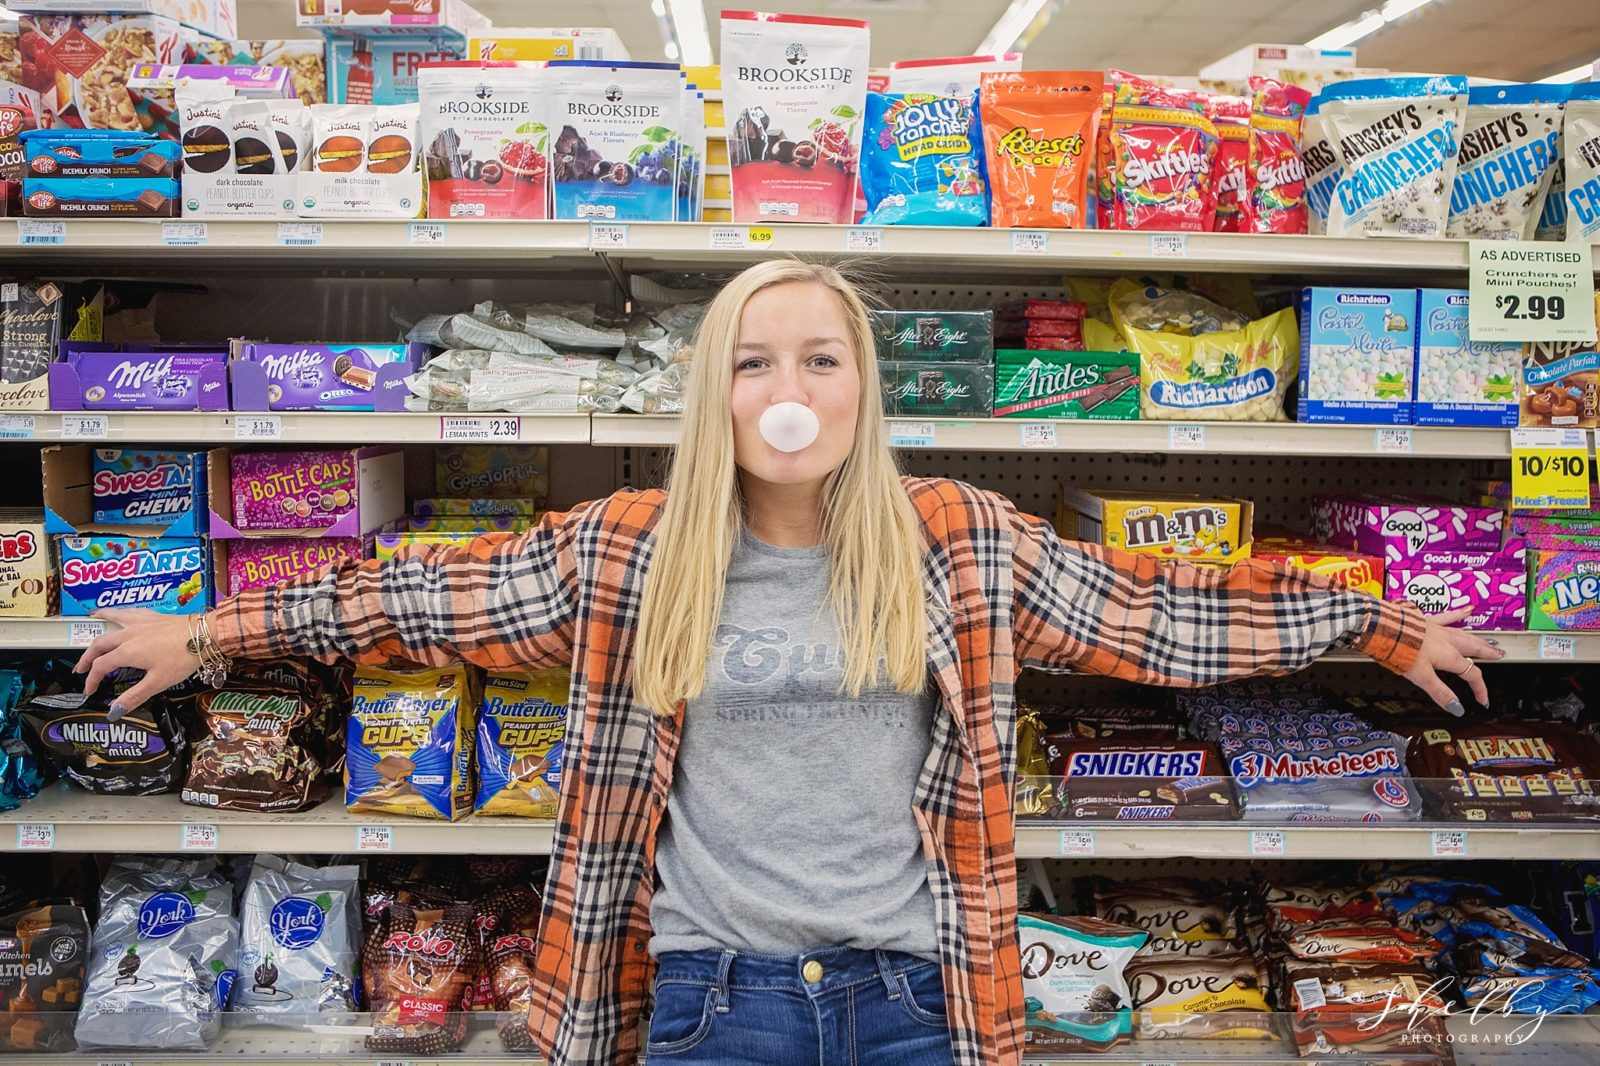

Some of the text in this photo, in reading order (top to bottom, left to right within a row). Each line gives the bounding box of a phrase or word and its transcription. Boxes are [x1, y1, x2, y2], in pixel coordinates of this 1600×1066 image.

[738, 67, 852, 84] BROOKSIDE
[440, 102, 530, 115] BROOKSIDE
[567, 103, 659, 118] BROOKSIDE
[775, 100, 819, 108] Pomegranate
[186, 108, 222, 121] Justin's
[895, 98, 960, 133] JOLLY
[232, 120, 259, 131] ustin's
[328, 122, 361, 132] Justin's
[374, 119, 407, 131] Justin's
[900, 117, 969, 145] rancher
[464, 129, 503, 137] Pomegranate
[608, 130, 639, 139] Blueberry
[998, 127, 1084, 156] Reese's
[1124, 152, 1209, 188] Skittles
[1256, 160, 1306, 189] Skittl
[216, 178, 263, 186] dark chocolate
[335, 177, 380, 185] milk chocolate
[206, 188, 227, 200] PEANUT
[231, 189, 255, 200] BUTTER
[227, 201, 254, 209] organic
[344, 199, 371, 208] organic
[1480, 251, 1581, 263] AS ADVERTISED
[1485, 269, 1559, 279] Crunchers
[1486, 279, 1577, 288] Mini Pouches!
[1341, 295, 1388, 304] Richardson
[1495, 295, 1565, 321] $2.99
[1318, 305, 1364, 332] Pastel
[3, 330, 48, 344] Strong
[885, 327, 969, 346] After Eight
[1340, 333, 1407, 355] Mints
[261, 350, 325, 380] Milka
[1568, 355, 1598, 373] Parfait
[108, 355, 176, 389] Milk
[887, 380, 971, 399] After Eight
[1013, 363, 1100, 401] Andes
[320, 389, 354, 401] OREO
[1160, 375, 1270, 405] Richardson
[445, 431, 468, 439] LEMAN
[490, 420, 517, 436] $2.39
[309, 457, 352, 486] CAPS
[94, 464, 192, 496] SweeTA
[149, 490, 178, 500] MINI
[124, 496, 192, 518] CHEWY
[1128, 507, 1152, 517] PEANUT
[1126, 508, 1228, 548] m&m's
[1387, 519, 1422, 533] Good
[303, 541, 347, 569] CAPS
[1424, 553, 1452, 564] Good
[1459, 553, 1491, 567] Plenty
[122, 578, 152, 587] MINI
[1408, 584, 1445, 596] Good
[96, 582, 170, 608] CHEWY
[1413, 601, 1448, 613] lenty
[353, 696, 450, 717] Butterfinger
[486, 698, 567, 718] Butterfing
[247, 716, 282, 730] minis
[366, 717, 430, 727] PEANUT BUTTER
[504, 721, 534, 730] PEANUT
[363, 726, 430, 745] CUPS
[500, 725, 564, 747] CUPS
[109, 747, 143, 758] minis
[1457, 737, 1554, 765] HEATH
[1071, 752, 1202, 777] SNICKERS
[1264, 747, 1399, 779] Musketeers
[1075, 808, 1083, 818] 6
[1119, 806, 1174, 819] SNICKERS
[138, 904, 188, 939] York
[271, 907, 318, 946] York
[384, 931, 455, 955] ROLO
[1305, 940, 1344, 956] Dove
[1021, 941, 1108, 980] Dove
[0, 958, 53, 980] amels
[1132, 972, 1241, 1010] Dove
[403, 1000, 443, 1013] CLASSIC
[1182, 997, 1211, 1011] Caramel
[1209, 998, 1247, 1011] Chocolate
